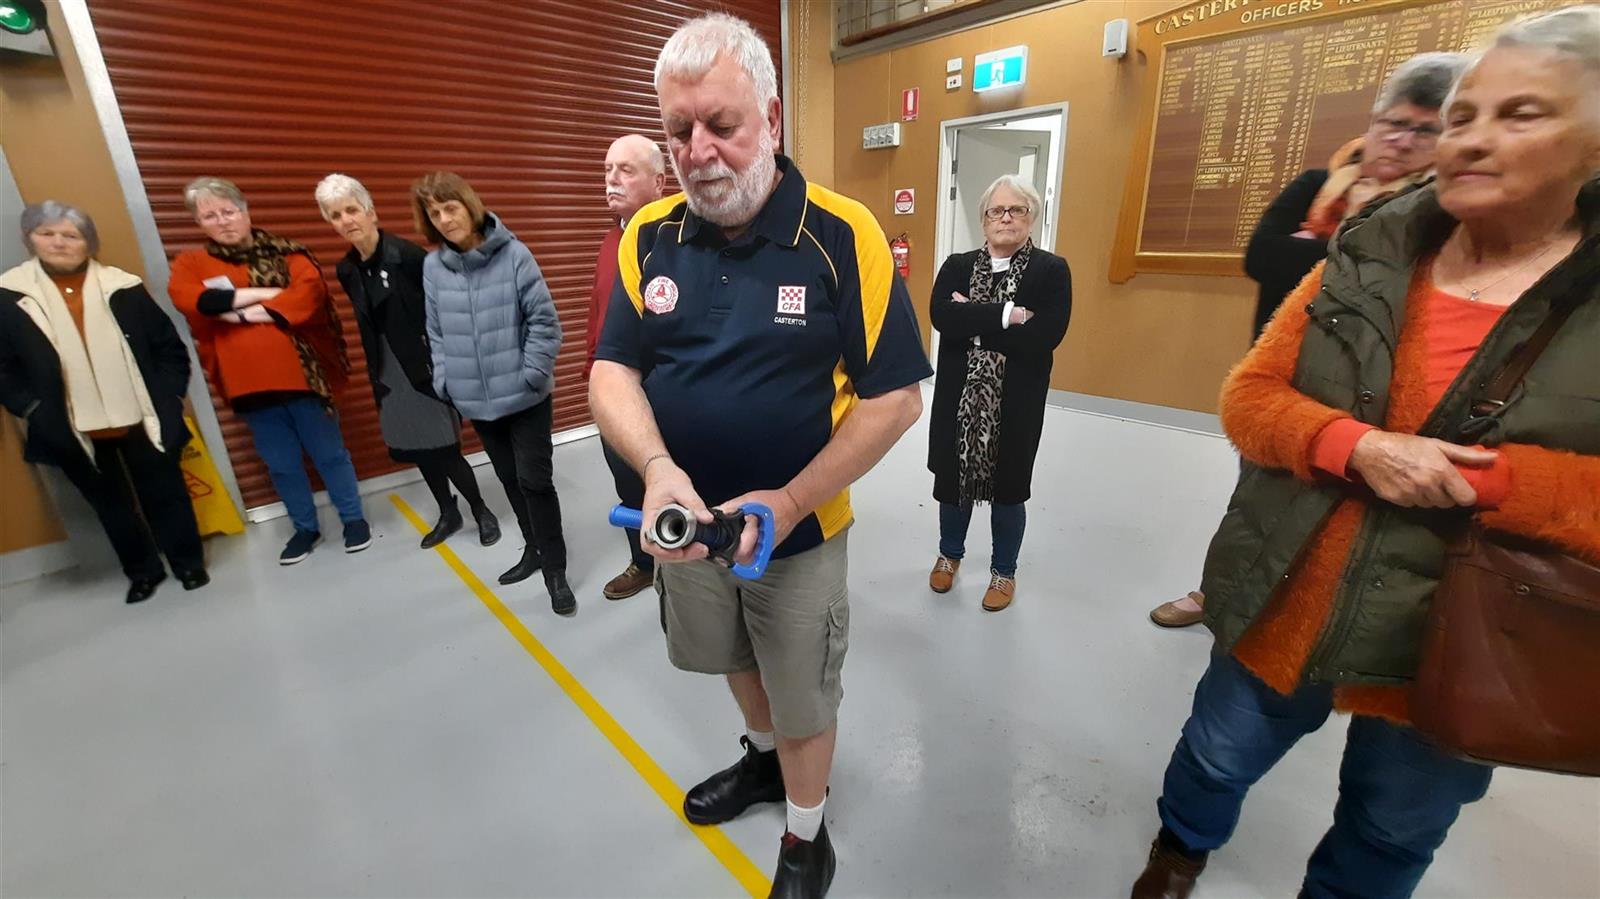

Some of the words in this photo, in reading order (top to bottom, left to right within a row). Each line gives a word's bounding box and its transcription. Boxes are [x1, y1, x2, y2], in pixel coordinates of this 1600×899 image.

[1241, 0, 1323, 23] OFFICERS
[782, 302, 801, 311] CFA
[774, 316, 807, 326] CASTERTON
